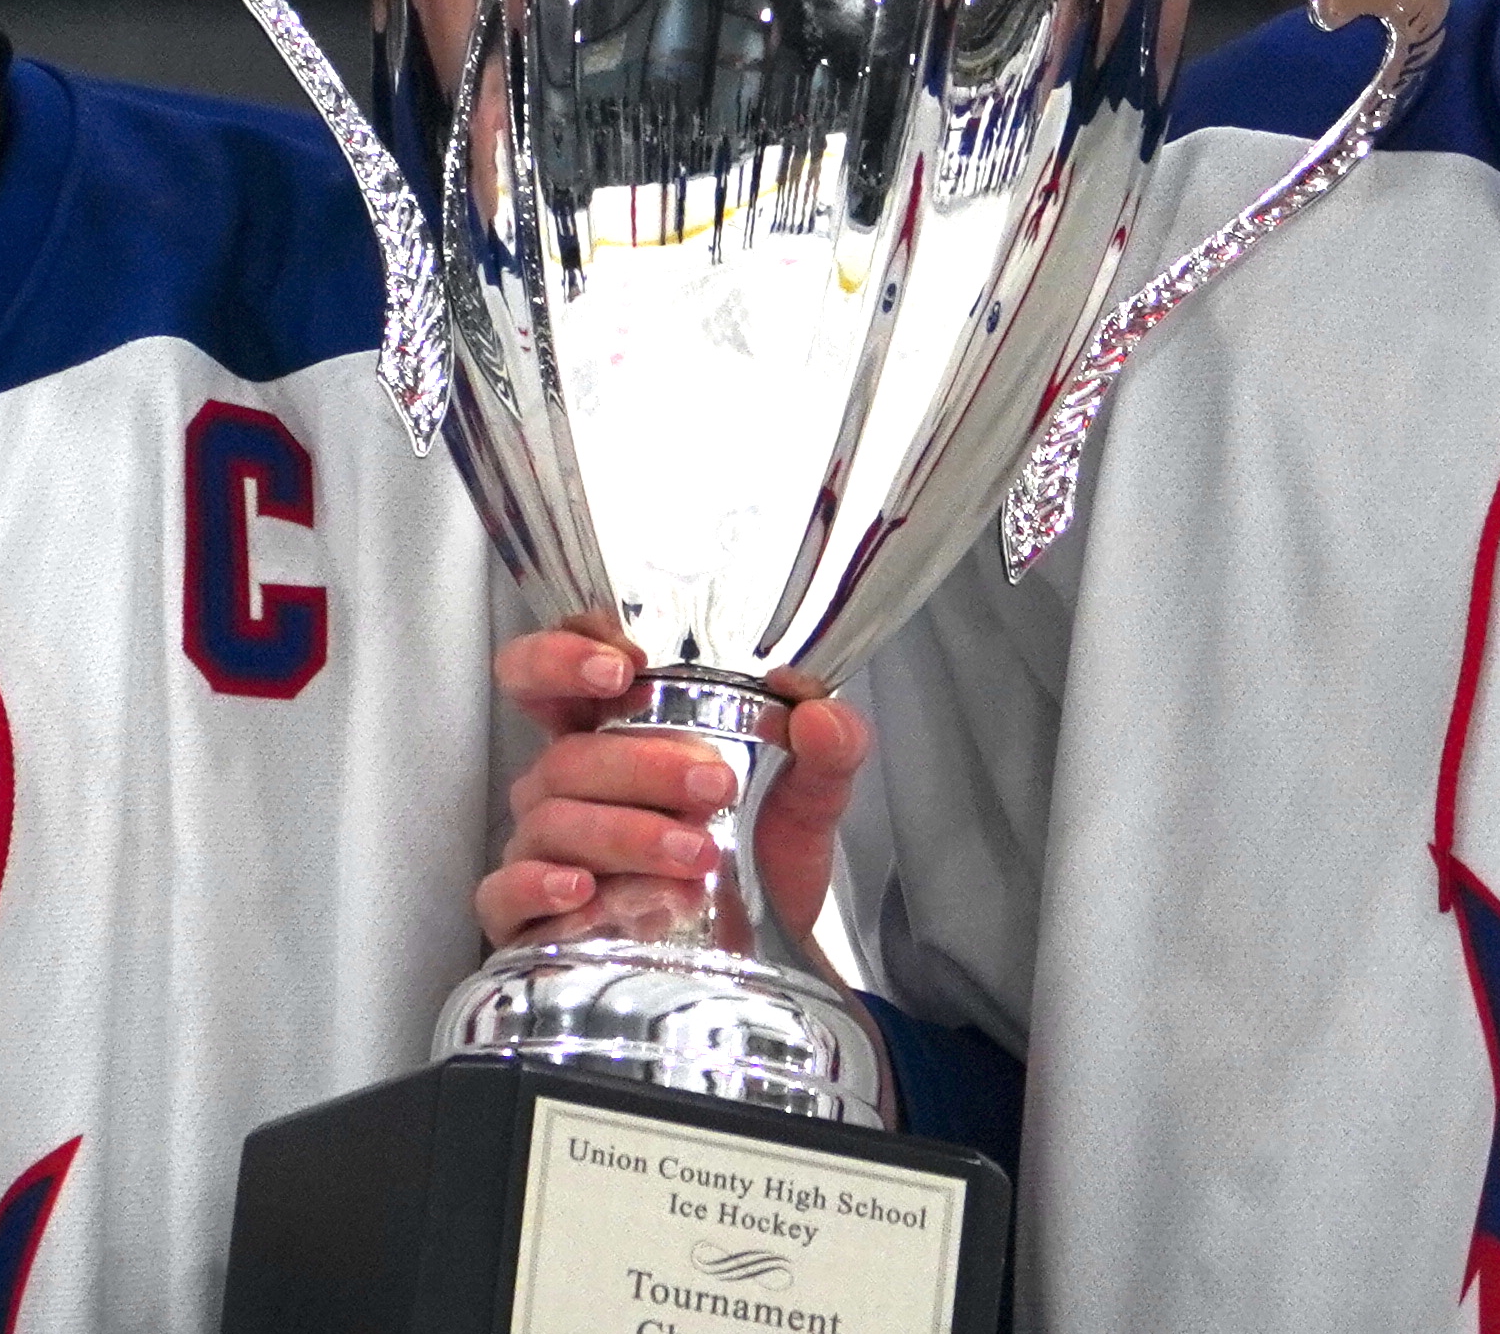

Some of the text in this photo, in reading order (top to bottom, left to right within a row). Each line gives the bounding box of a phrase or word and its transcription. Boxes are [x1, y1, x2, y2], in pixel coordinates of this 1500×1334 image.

[183, 399, 328, 700] C
[569, 1138, 928, 1230] Union County High School
[669, 1192, 820, 1247] Ice Hockey
